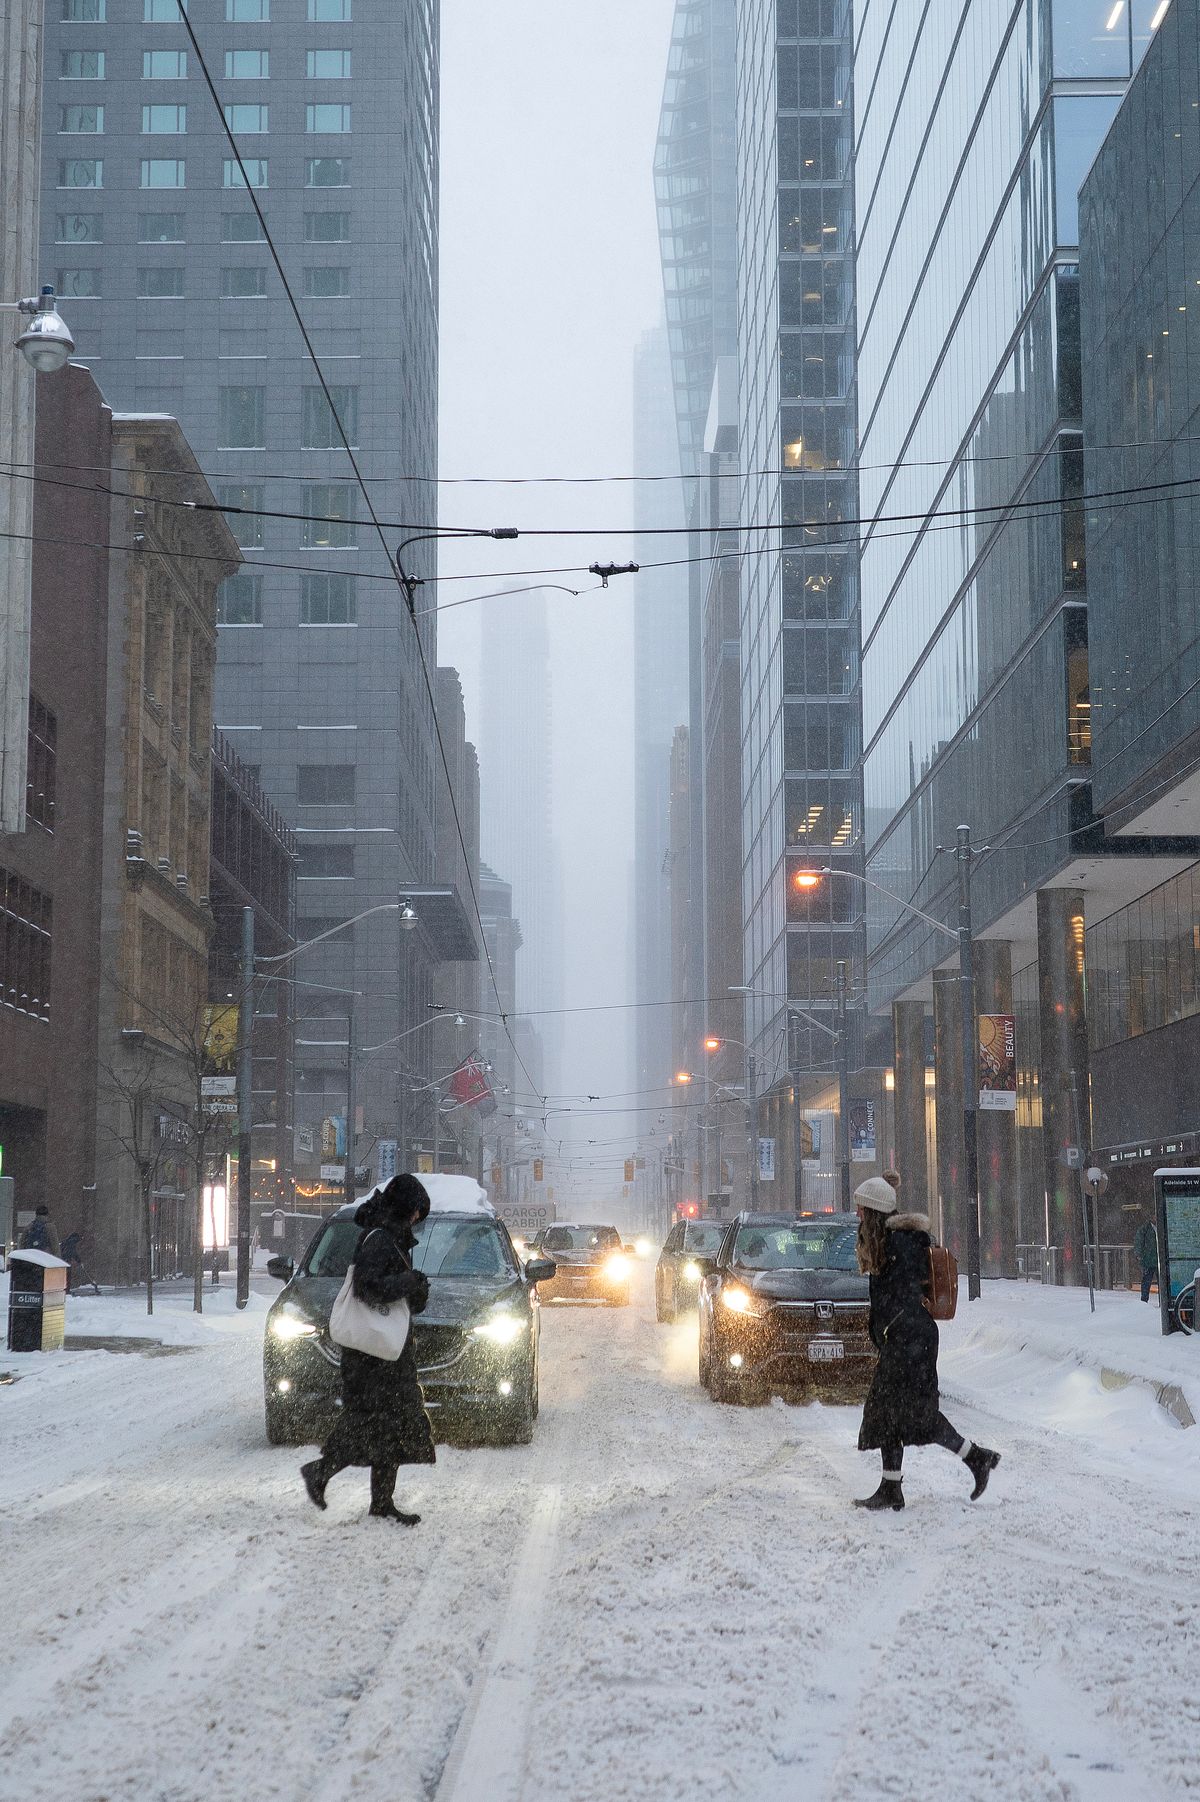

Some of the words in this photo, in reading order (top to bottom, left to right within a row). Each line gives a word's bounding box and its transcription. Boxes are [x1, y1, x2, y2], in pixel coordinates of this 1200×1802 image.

[1005, 1020, 1014, 1057] BEAUTY
[1067, 1148, 1079, 1166] P
[504, 1207, 546, 1217] CARGO
[505, 1218, 546, 1228] CABBIE
